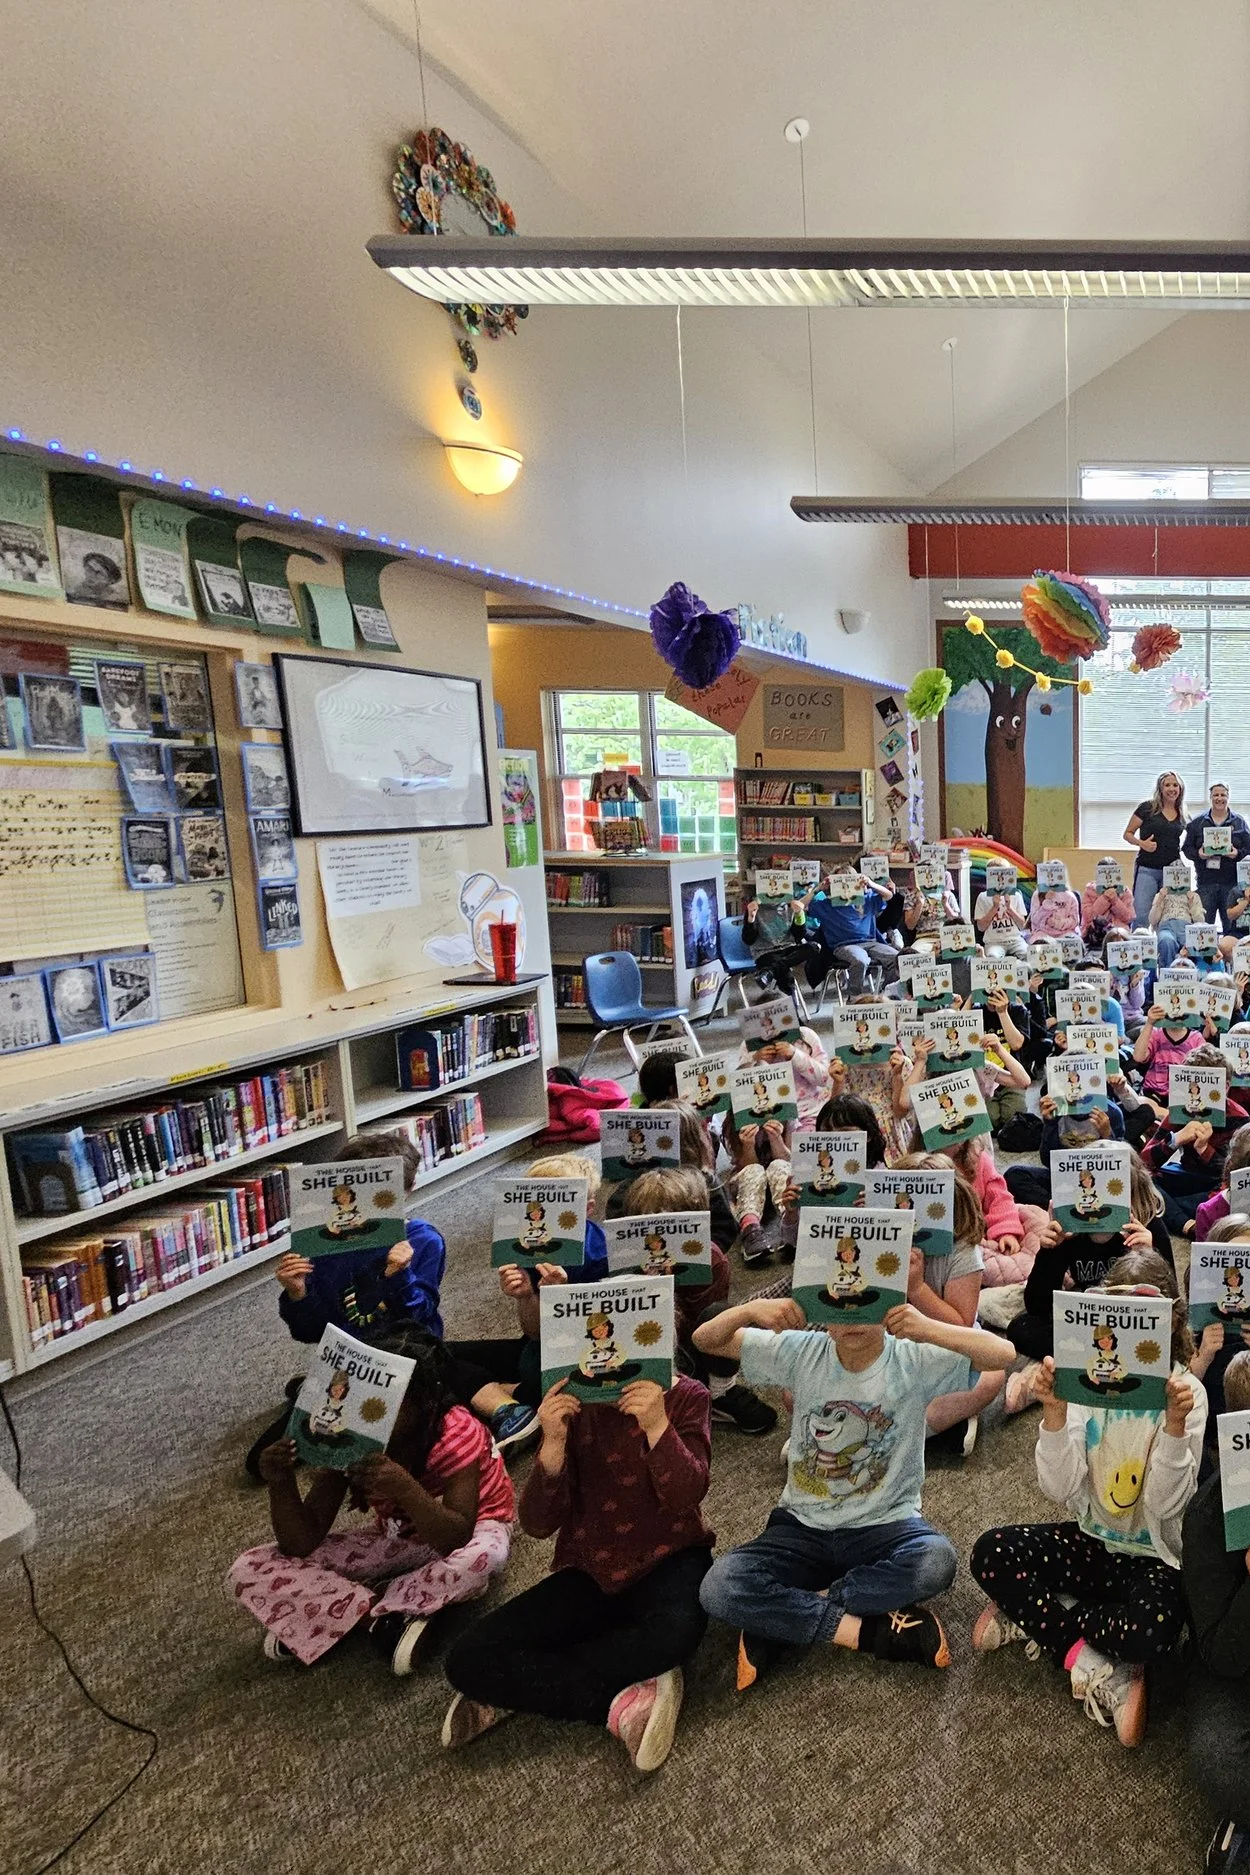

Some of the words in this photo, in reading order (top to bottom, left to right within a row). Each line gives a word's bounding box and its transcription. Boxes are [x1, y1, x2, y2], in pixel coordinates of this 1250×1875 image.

[771, 691, 833, 707] BOOKS
[790, 711, 811, 720] are
[769, 727, 829, 742] GREAT
[256, 820, 290, 832] AMARI
[268, 899, 298, 922] LINKED
[839, 1013, 859, 1021] SHE
[861, 1011, 889, 1021] BUILT
[2, 1030, 41, 1049] FISH
[1225, 1041, 1241, 1049] SHE
[735, 1076, 756, 1087] SHE
[759, 1071, 787, 1082] BUILT
[1175, 1075, 1193, 1083] SHE
[1196, 1075, 1220, 1084] BUILT
[918, 1088, 941, 1100] SHE
[943, 1079, 970, 1093] BUILT
[607, 1120, 633, 1129] SHE
[636, 1120, 671, 1129] BUILT
[799, 1142, 823, 1152] SHE
[826, 1142, 859, 1152] BUILT
[335, 1167, 365, 1175] HOUSE
[1058, 1160, 1082, 1172] SHE
[1088, 1160, 1122, 1171] BUILT
[302, 1176, 339, 1190] SHE
[343, 1170, 391, 1185] BUILT
[873, 1183, 900, 1194] SHE
[906, 1183, 945, 1194] BUILT
[504, 1191, 533, 1202] SHE
[536, 1191, 577, 1203] BUILT
[648, 1218, 675, 1227] HOUSE
[826, 1216, 842, 1225] THE
[845, 1216, 875, 1225] HOUSE
[616, 1227, 649, 1240] SHE
[654, 1222, 701, 1236] BUILT
[809, 1224, 843, 1239] SHE
[851, 1226, 901, 1242] BUILT
[1200, 1256, 1230, 1267] SHE
[569, 1291, 587, 1300] THE
[589, 1288, 628, 1299] HOUSE
[553, 1302, 595, 1318] SHE
[600, 1295, 661, 1315] BUILT
[1079, 1303, 1096, 1311] THE
[1098, 1305, 1130, 1313] HOUSE
[1064, 1310, 1100, 1326] SHE
[1106, 1315, 1159, 1330] BUILT
[335, 1341, 350, 1352] THE
[348, 1347, 372, 1364] HOUSE
[321, 1349, 345, 1371] SHE
[346, 1361, 396, 1388] BUILT
